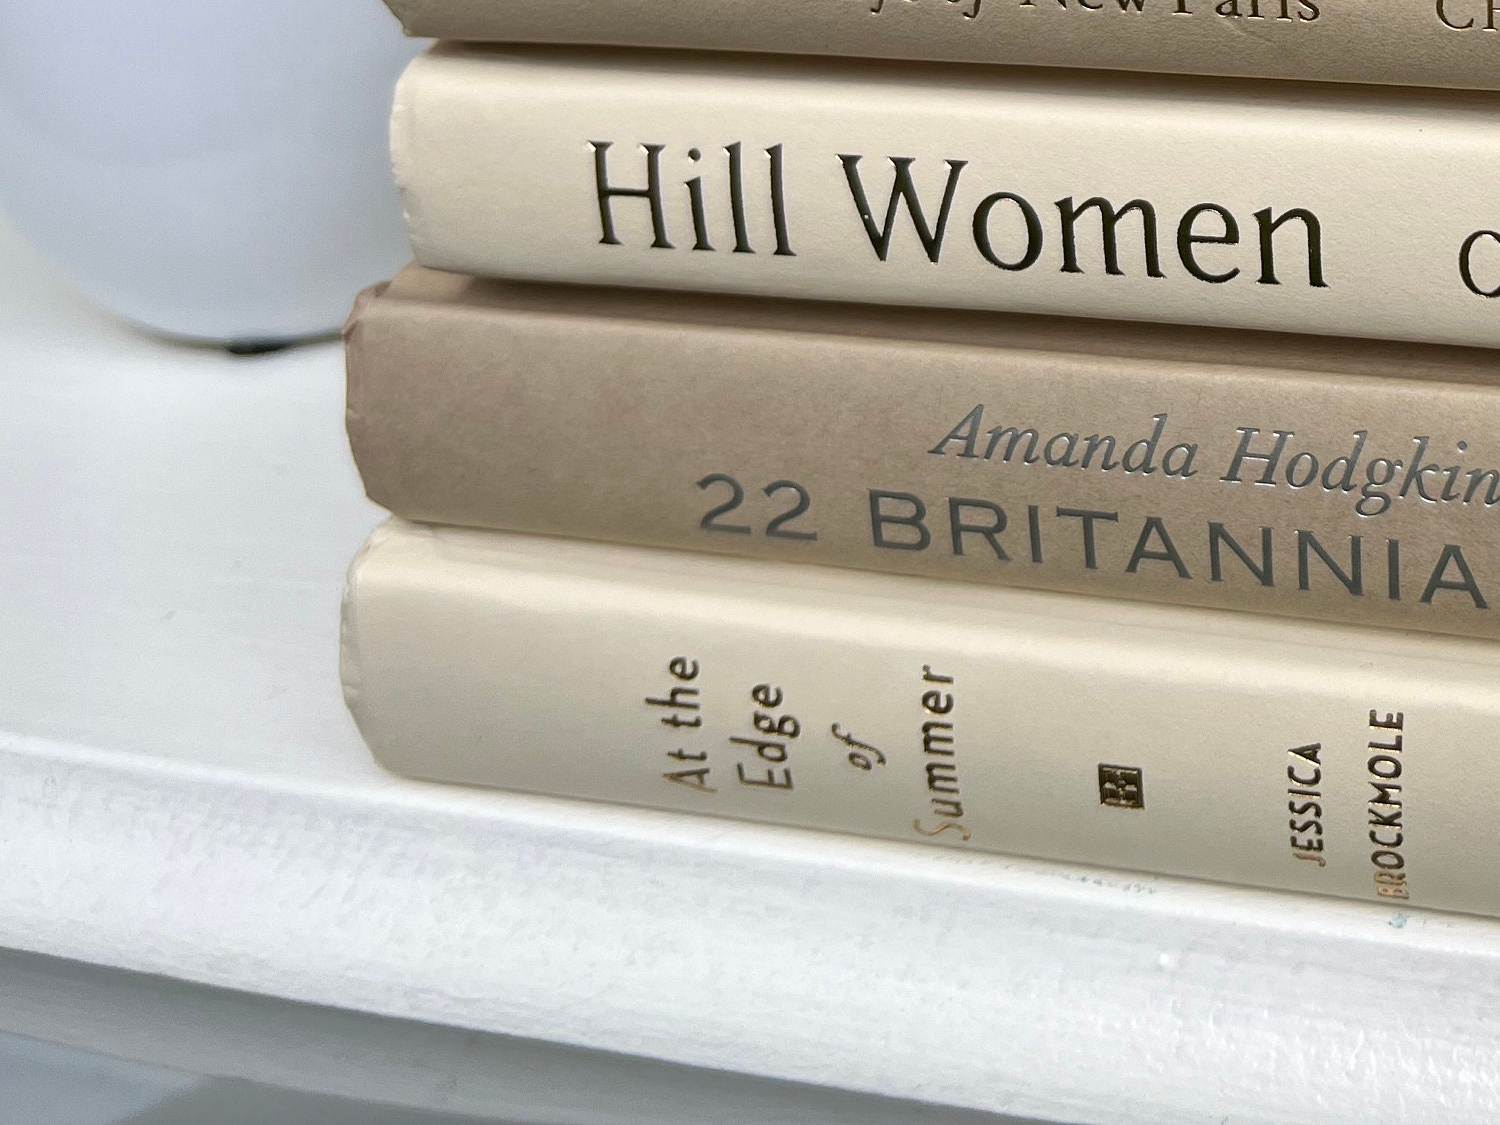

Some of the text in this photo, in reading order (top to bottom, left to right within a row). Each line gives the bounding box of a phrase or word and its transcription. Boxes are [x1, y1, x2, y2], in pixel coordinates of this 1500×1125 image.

[587, 139, 1329, 288] Hill Women
[928, 403, 1199, 478] Amanda
[696, 473, 818, 542] 22
[869, 488, 1489, 610] BRITANNIA
[645, 655, 715, 793] At the
[728, 683, 799, 791] Edge
[832, 722, 887, 772] of
[914, 664, 971, 841] Summer
[1287, 741, 1326, 867] JESSICA
[1368, 708, 1409, 901] BROCKMOLE
